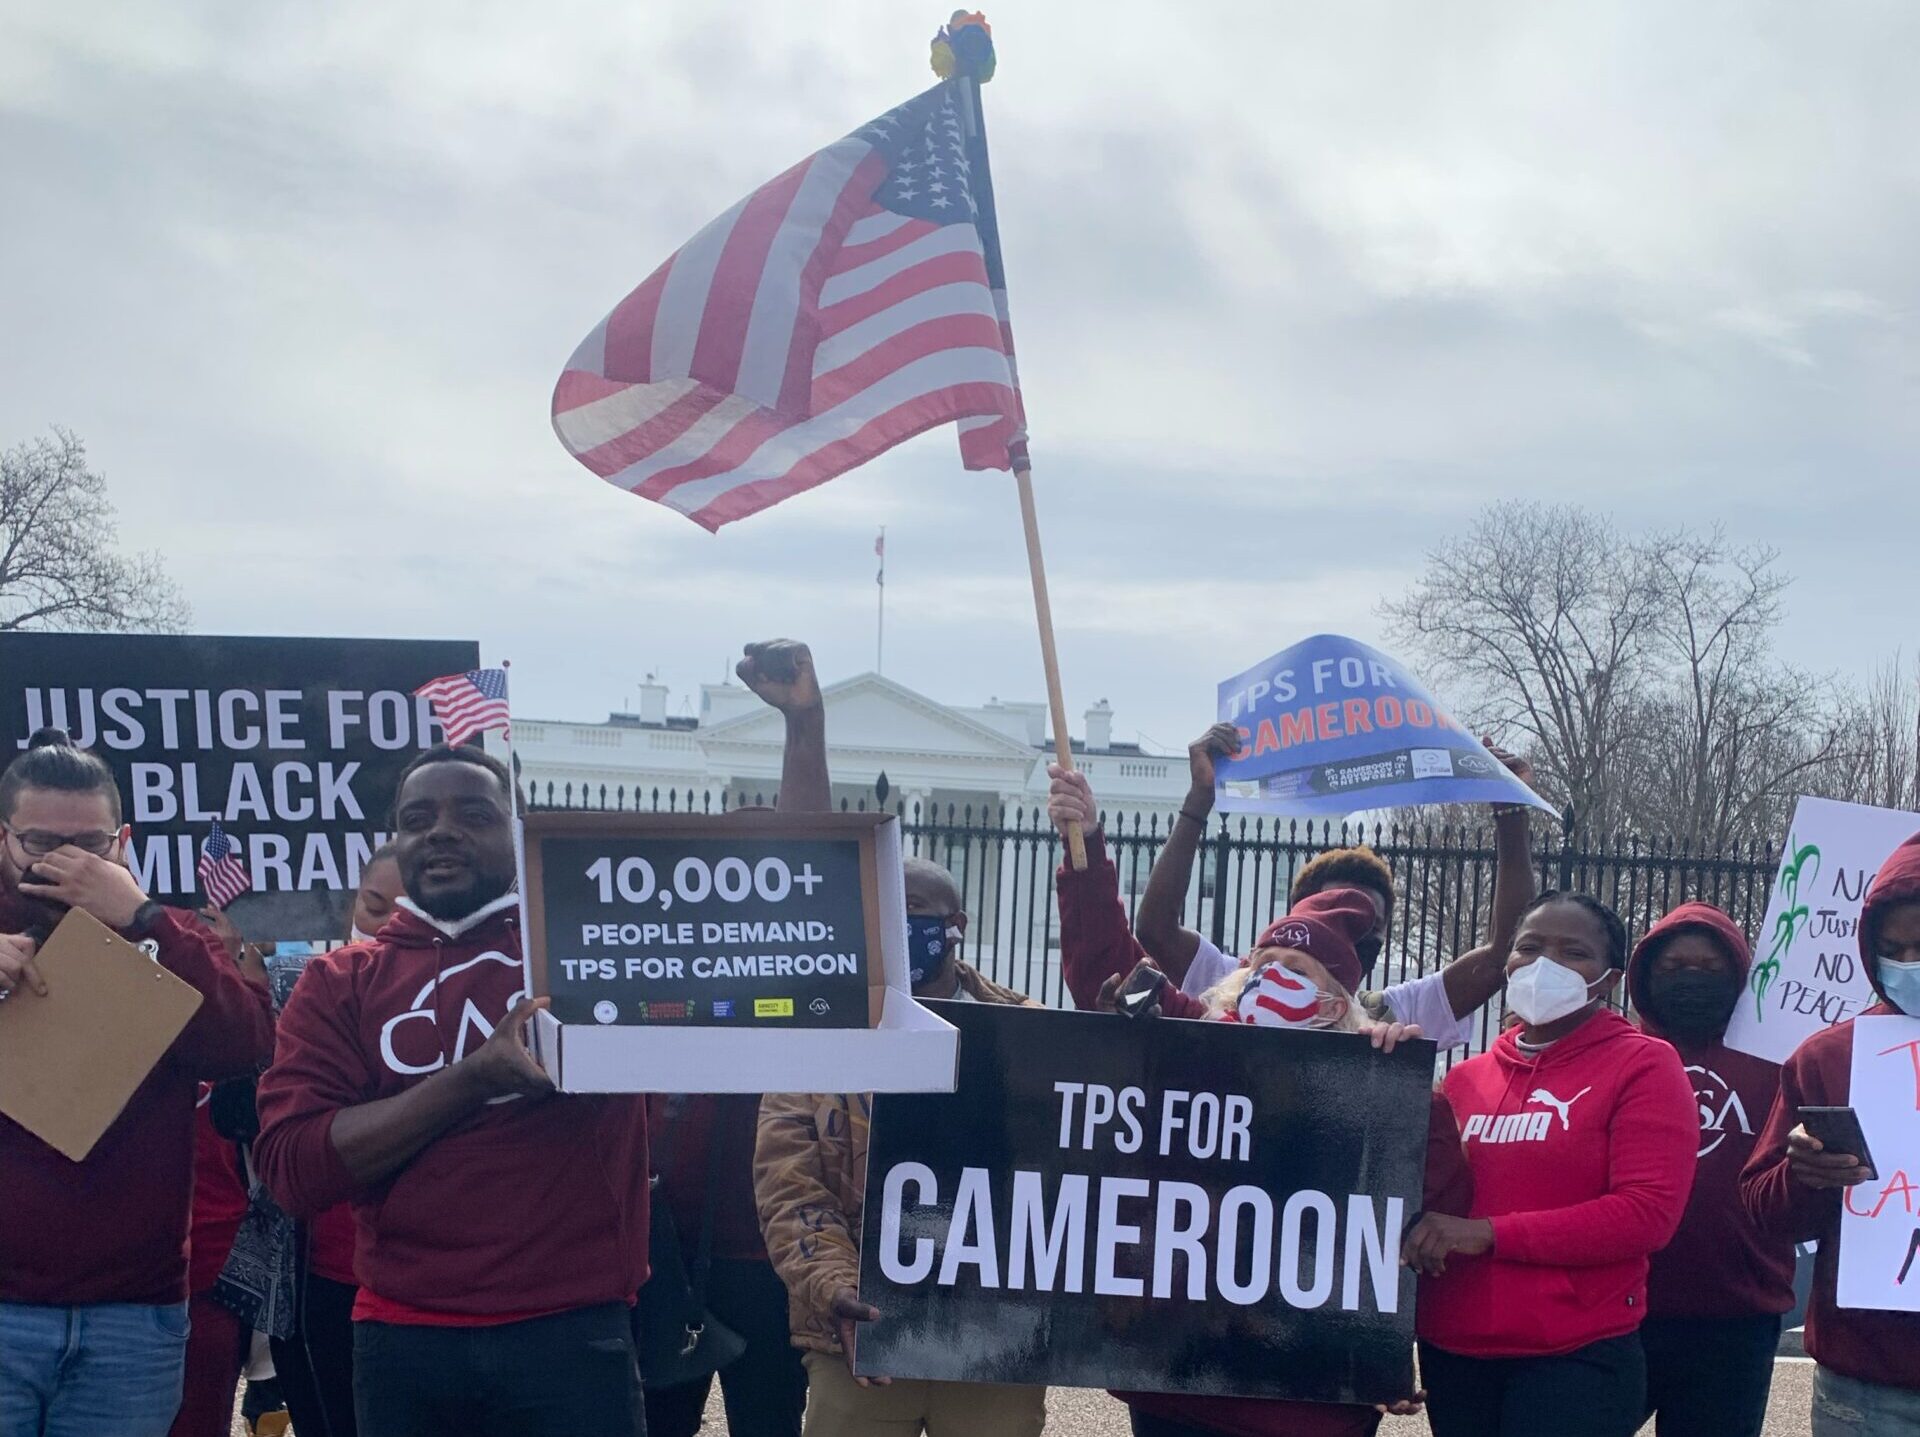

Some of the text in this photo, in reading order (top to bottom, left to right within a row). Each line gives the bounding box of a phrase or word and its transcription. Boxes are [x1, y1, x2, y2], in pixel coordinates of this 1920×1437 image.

[1226, 656, 1397, 720] TPS FOR
[17, 687, 305, 750] JUSTICE
[1340, 761, 1392, 775] CAMEROON
[1340, 767, 1393, 780] ADVOCACY
[1340, 771, 1394, 786] NETWORK
[131, 762, 364, 822] BLACK
[585, 856, 823, 911] 10,000+
[582, 920, 834, 946] PEOPLE DEMAND:
[1272, 923, 1310, 946] CASA
[560, 953, 857, 981] TPS FOR CAMEROON
[1813, 953, 1854, 983] NO
[1054, 1081, 1253, 1161] TPS FOR
[1461, 1111, 1552, 1143] PUMA
[878, 1161, 1404, 1313] CAMEROON
